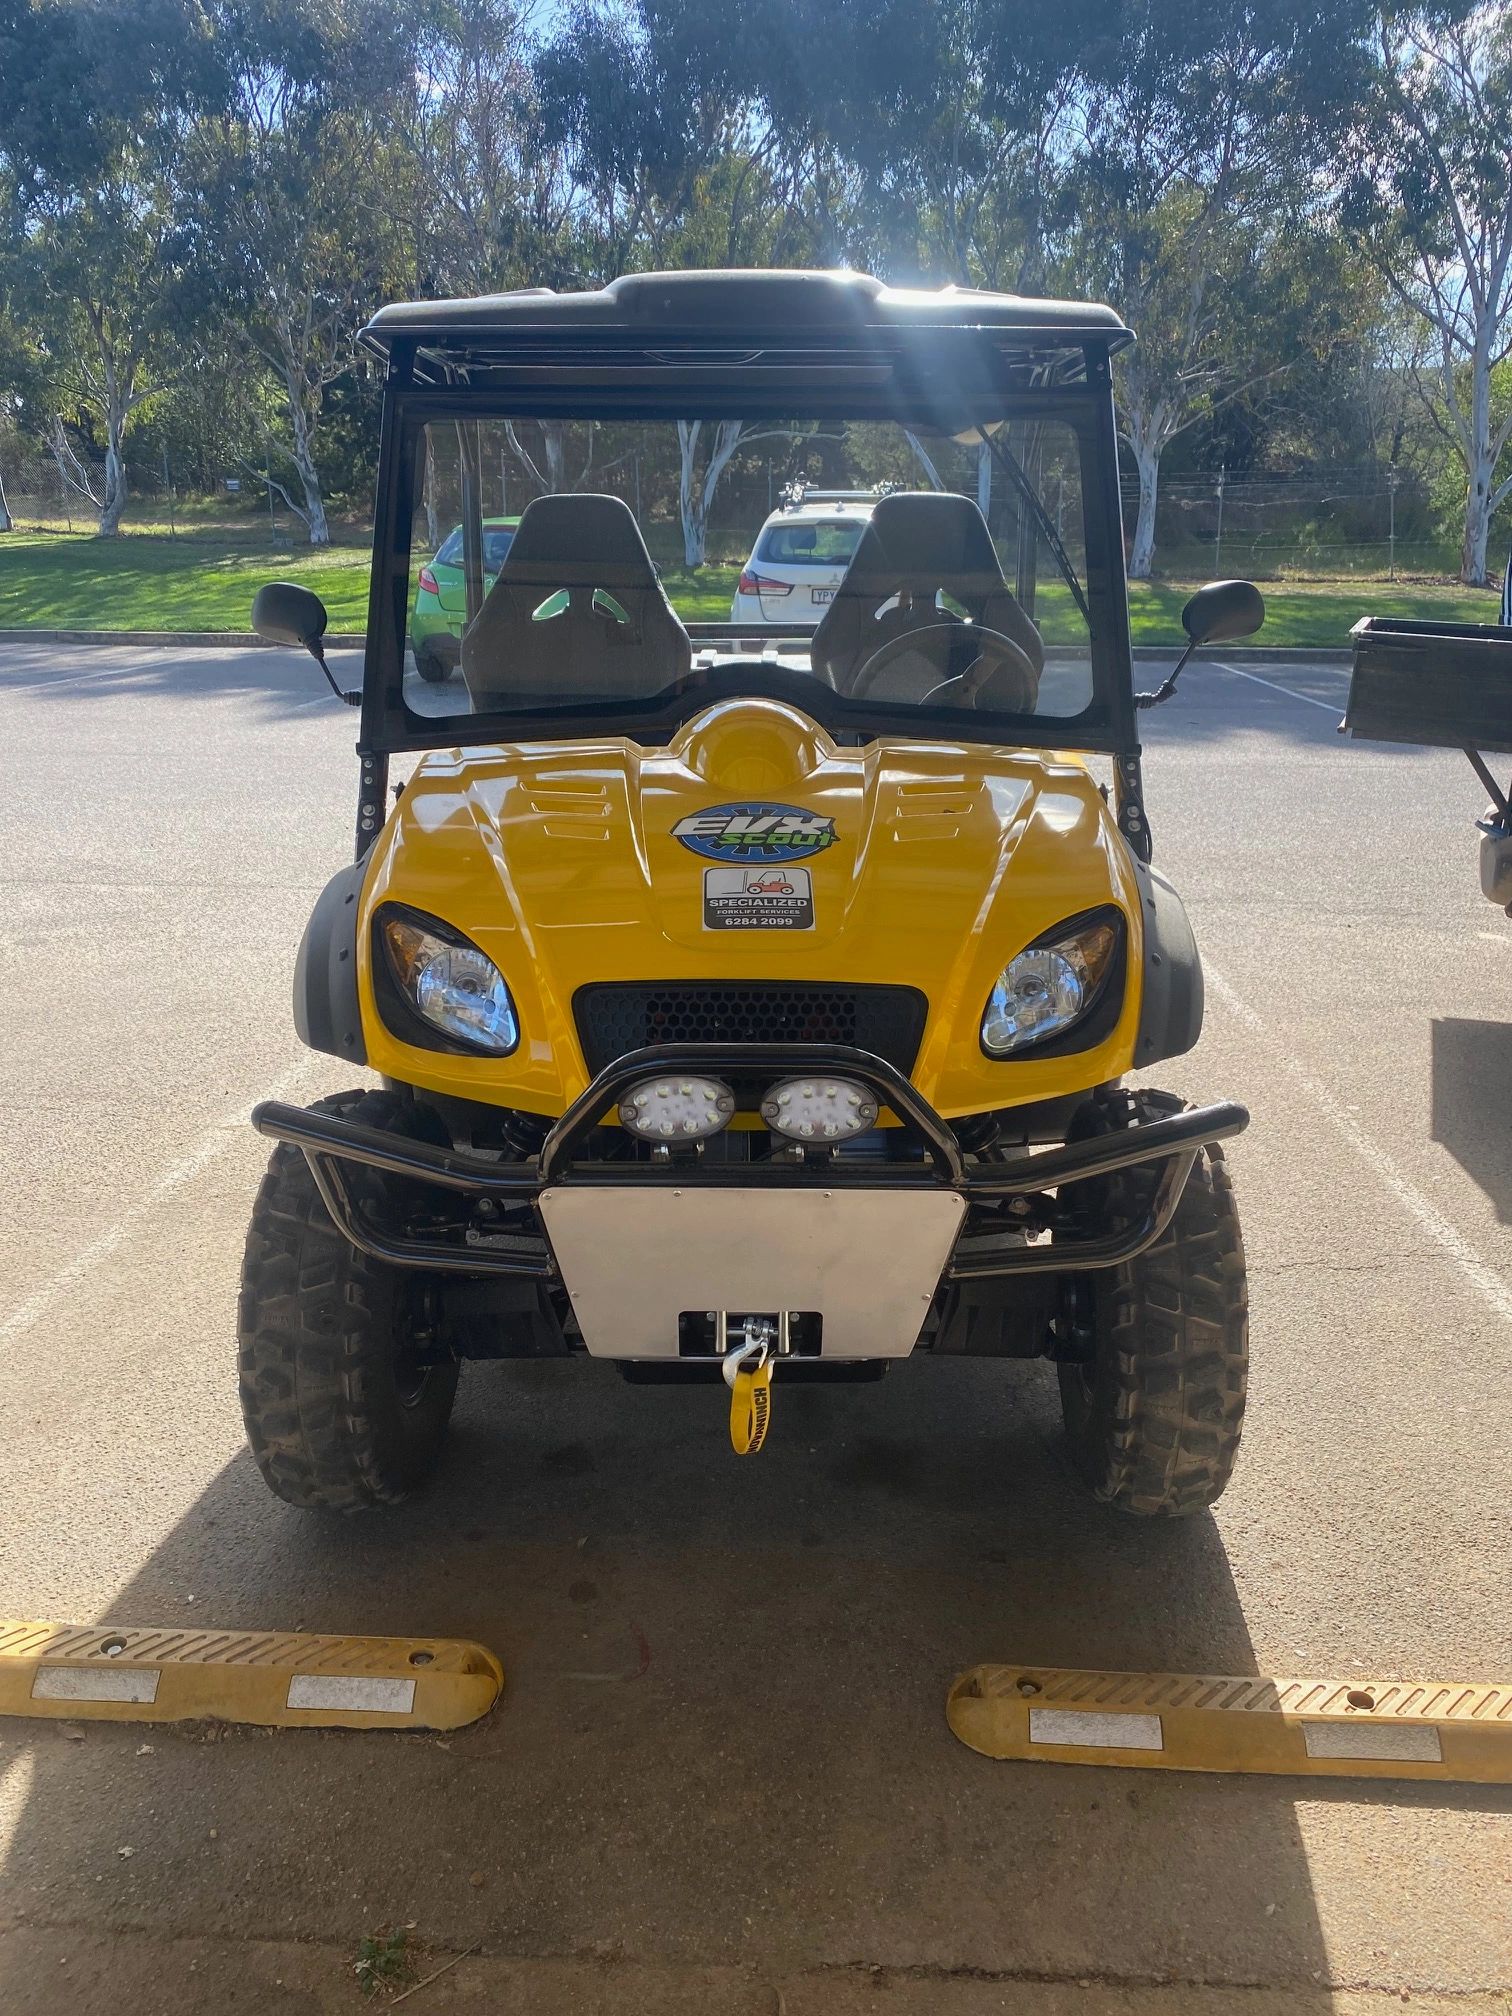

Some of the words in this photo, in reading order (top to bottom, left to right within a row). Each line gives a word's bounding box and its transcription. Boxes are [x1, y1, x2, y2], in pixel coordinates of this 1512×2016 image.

[709, 898, 808, 907] SPECIALIZED
[725, 917, 757, 926] 6284
[760, 917, 793, 926] 2099
